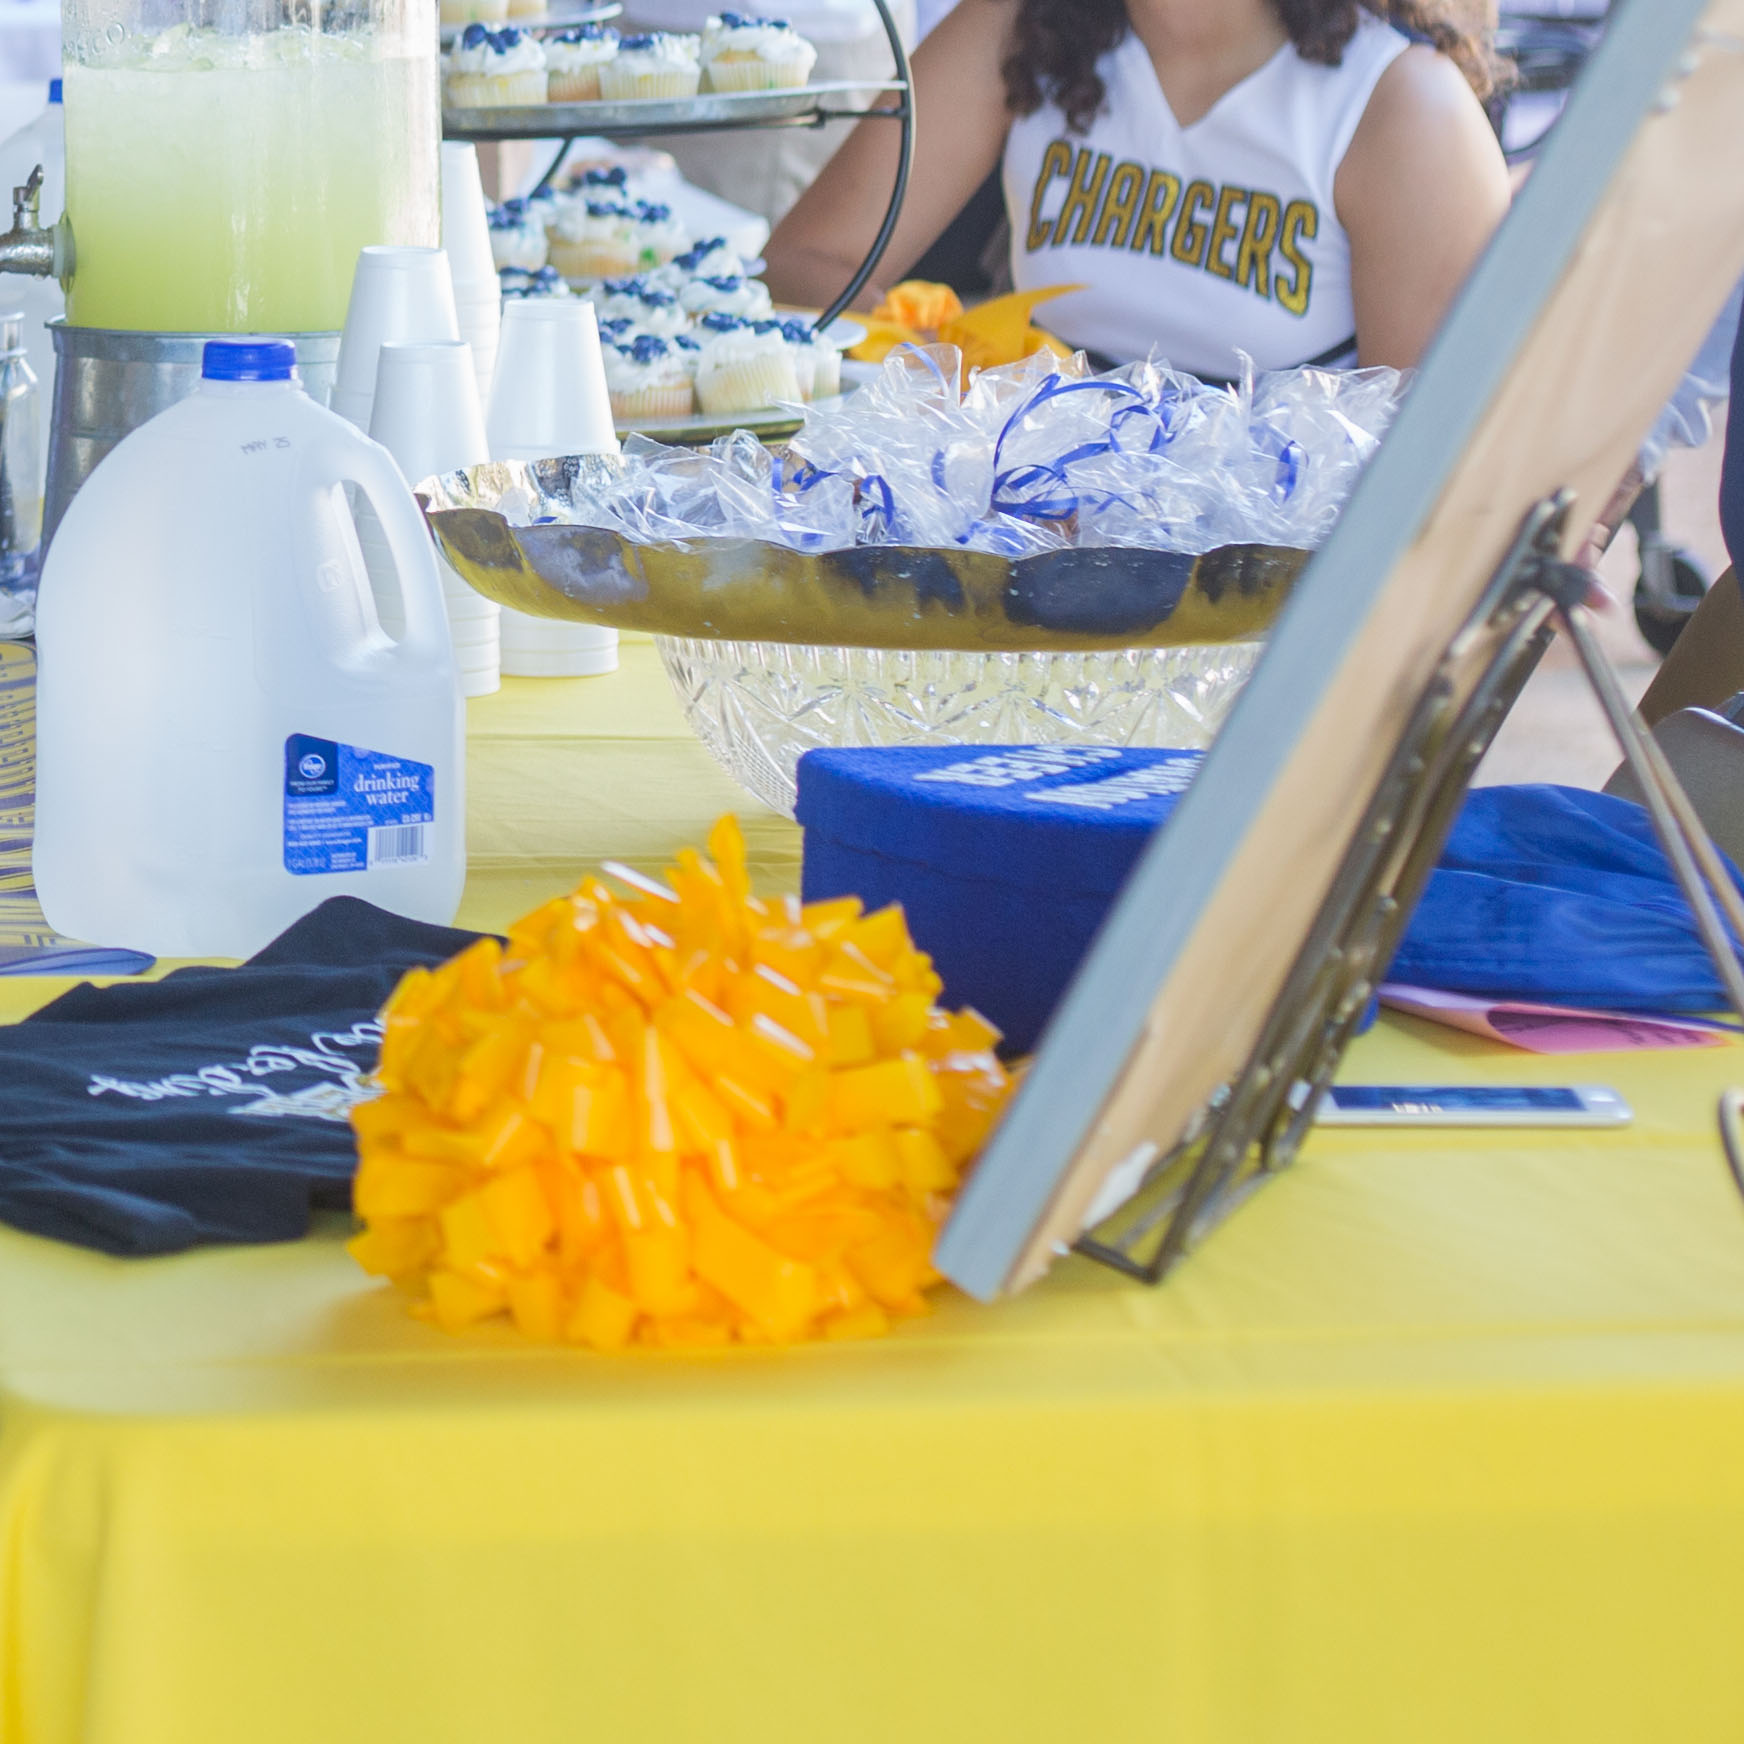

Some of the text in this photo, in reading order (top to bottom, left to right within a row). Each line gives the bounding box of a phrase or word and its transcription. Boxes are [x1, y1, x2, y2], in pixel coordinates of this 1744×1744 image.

[1026, 141, 1319, 318] CHARGERS
[354, 772, 419, 793] drinking
[366, 791, 408, 806] water
